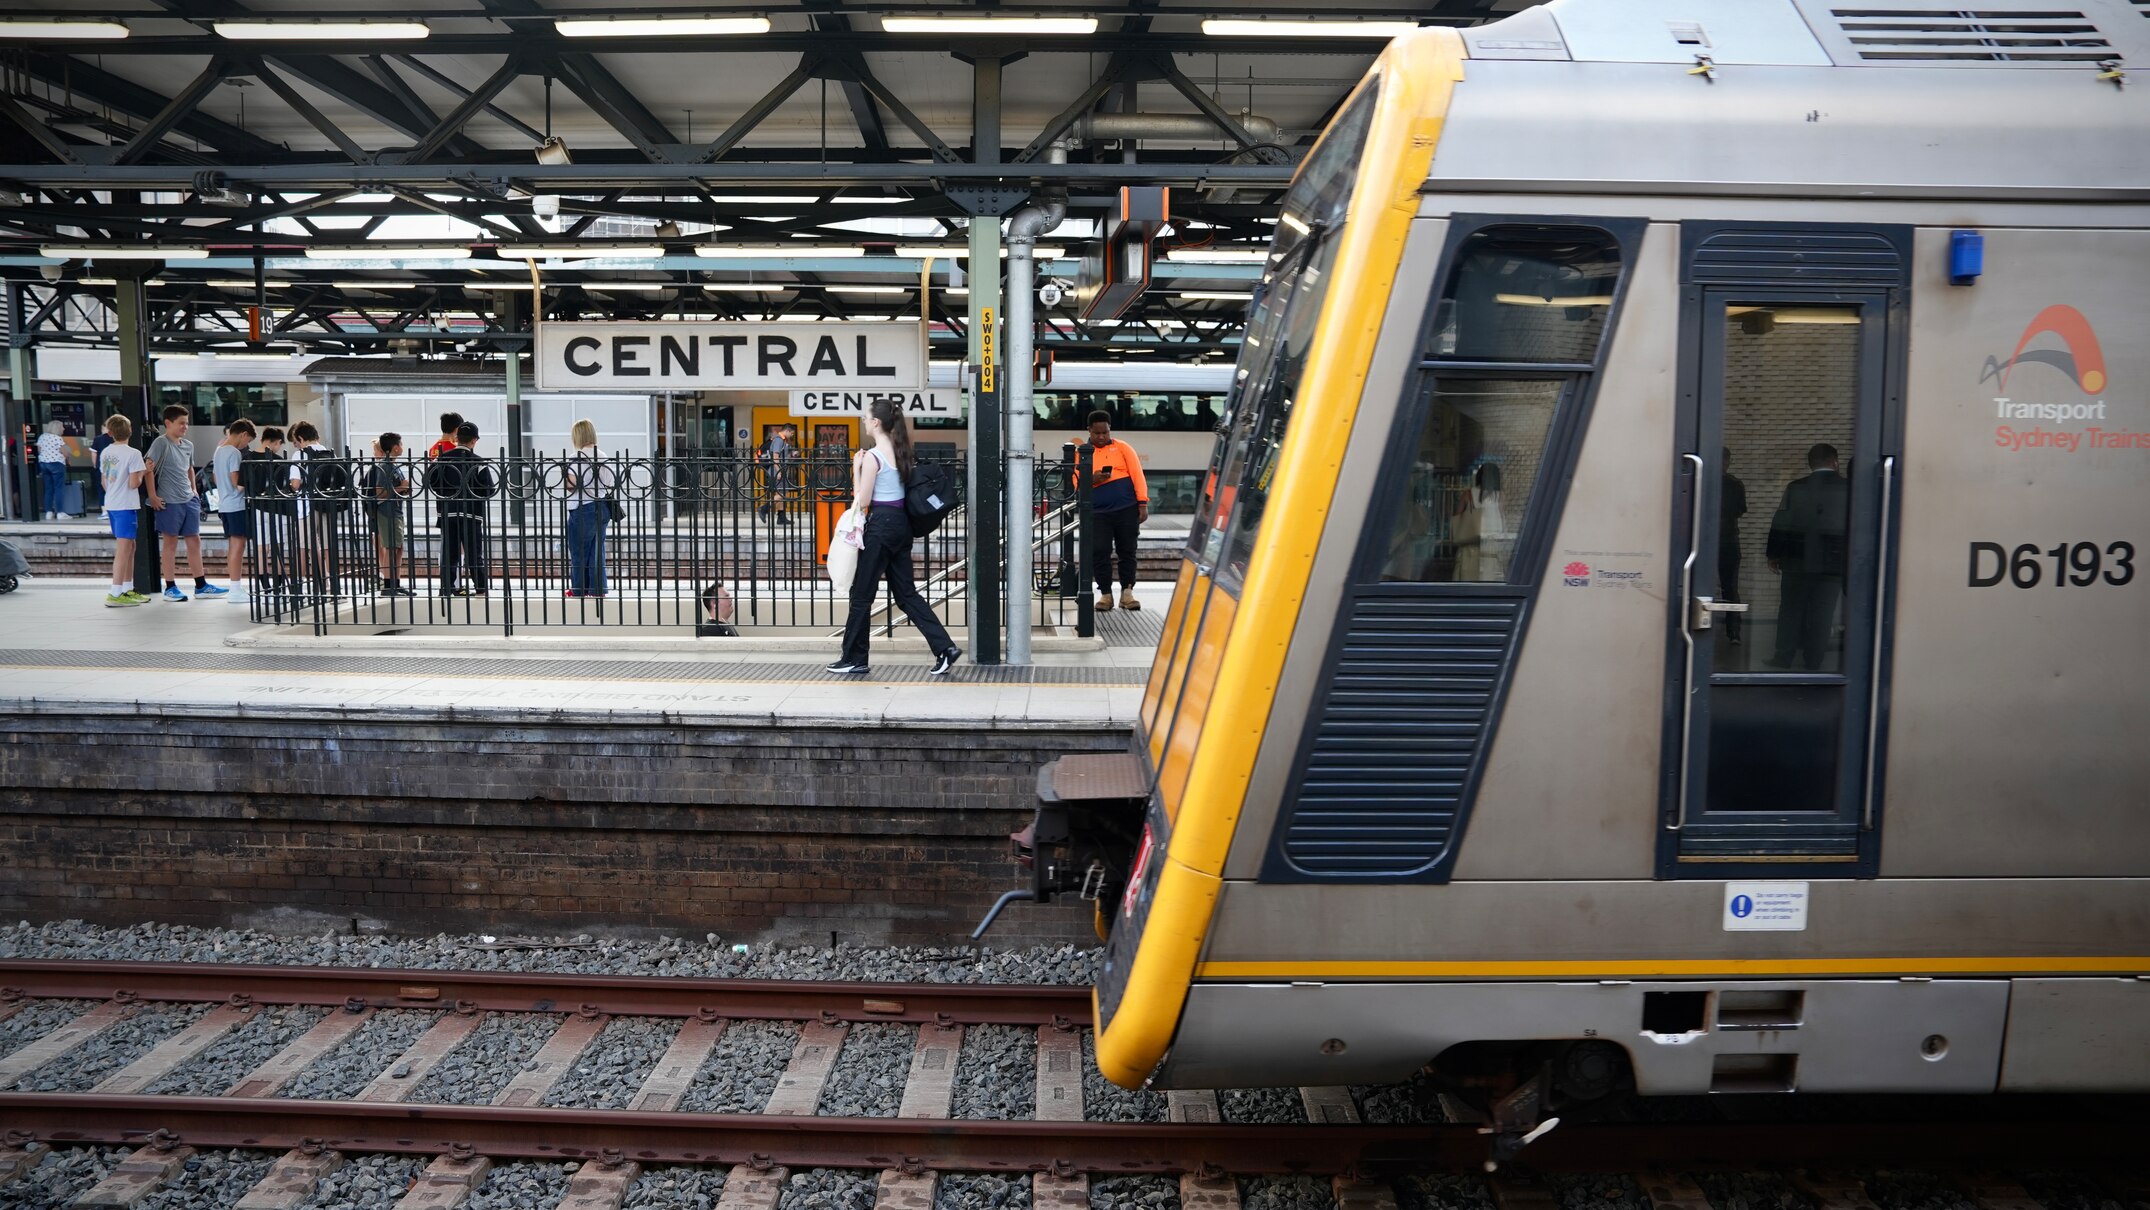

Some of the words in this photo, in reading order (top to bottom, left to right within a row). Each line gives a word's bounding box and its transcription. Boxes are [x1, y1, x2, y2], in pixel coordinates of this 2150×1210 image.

[260, 315, 273, 335] 19
[563, 334, 897, 377] CENTRAL
[1993, 397, 2107, 424] Transport
[1995, 425, 2083, 452] Sydney
[2085, 427, 2150, 449] Trains
[1597, 569, 1643, 580] Transport
[1968, 540, 2135, 590] D6193
